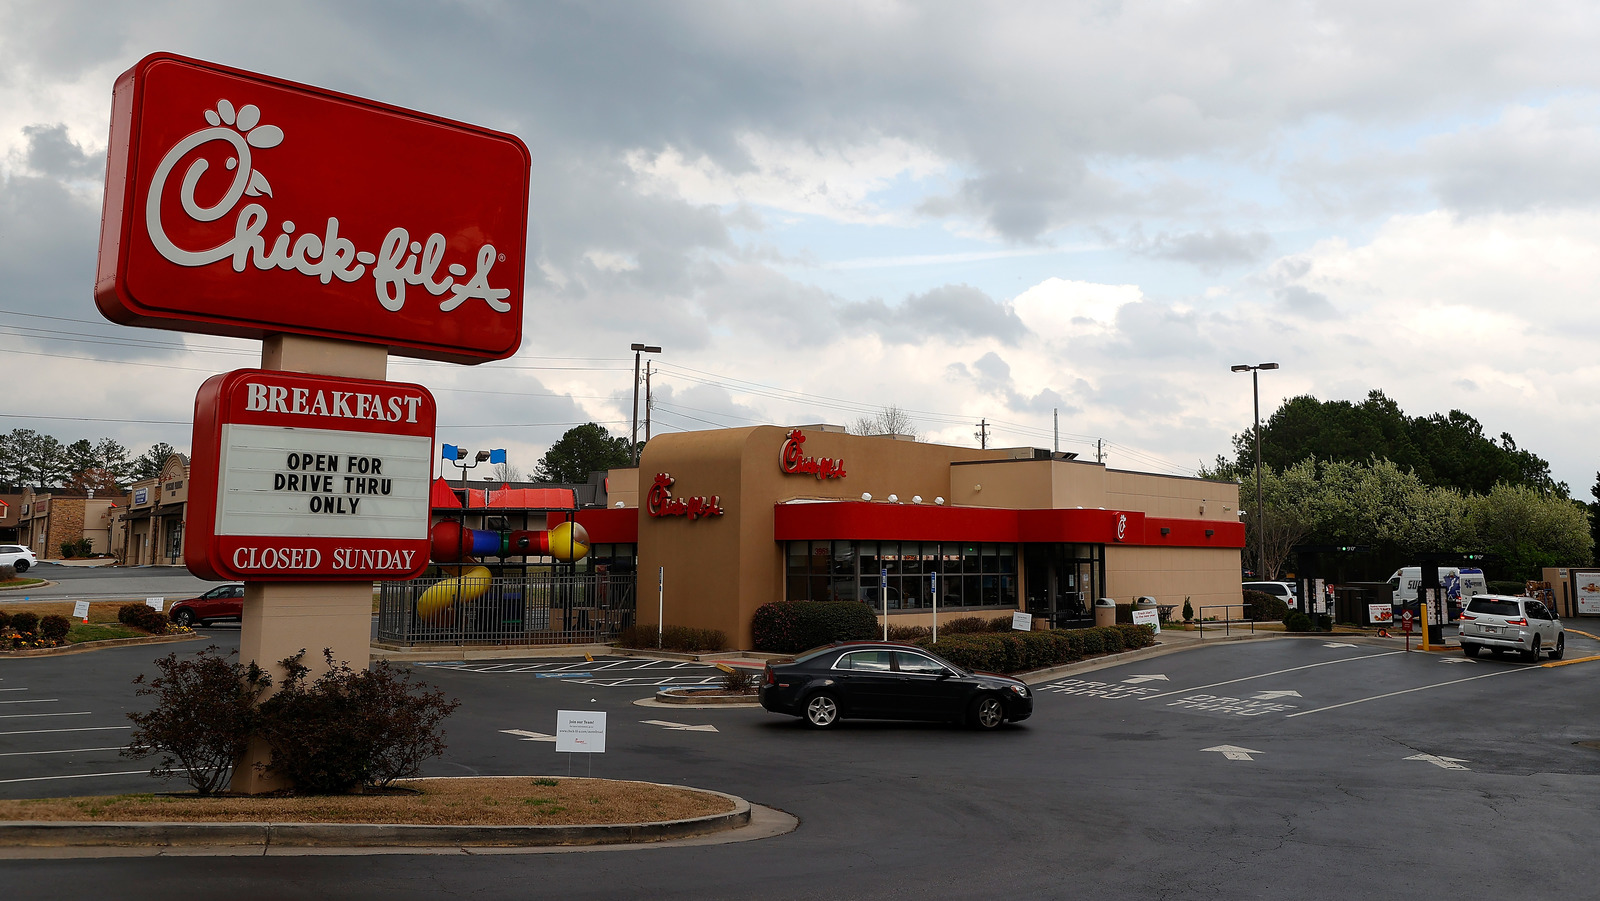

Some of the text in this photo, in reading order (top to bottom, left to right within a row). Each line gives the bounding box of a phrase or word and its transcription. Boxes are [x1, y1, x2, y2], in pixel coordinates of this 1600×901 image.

[146, 99, 511, 312] Chick-fil-A
[245, 383, 422, 424] BREAKFAST
[287, 453, 382, 475] OPEN FOR
[274, 473, 392, 495] DRIVE THRU
[309, 496, 360, 514] ONLY
[232, 547, 416, 570] CLOSED SUNDAY
